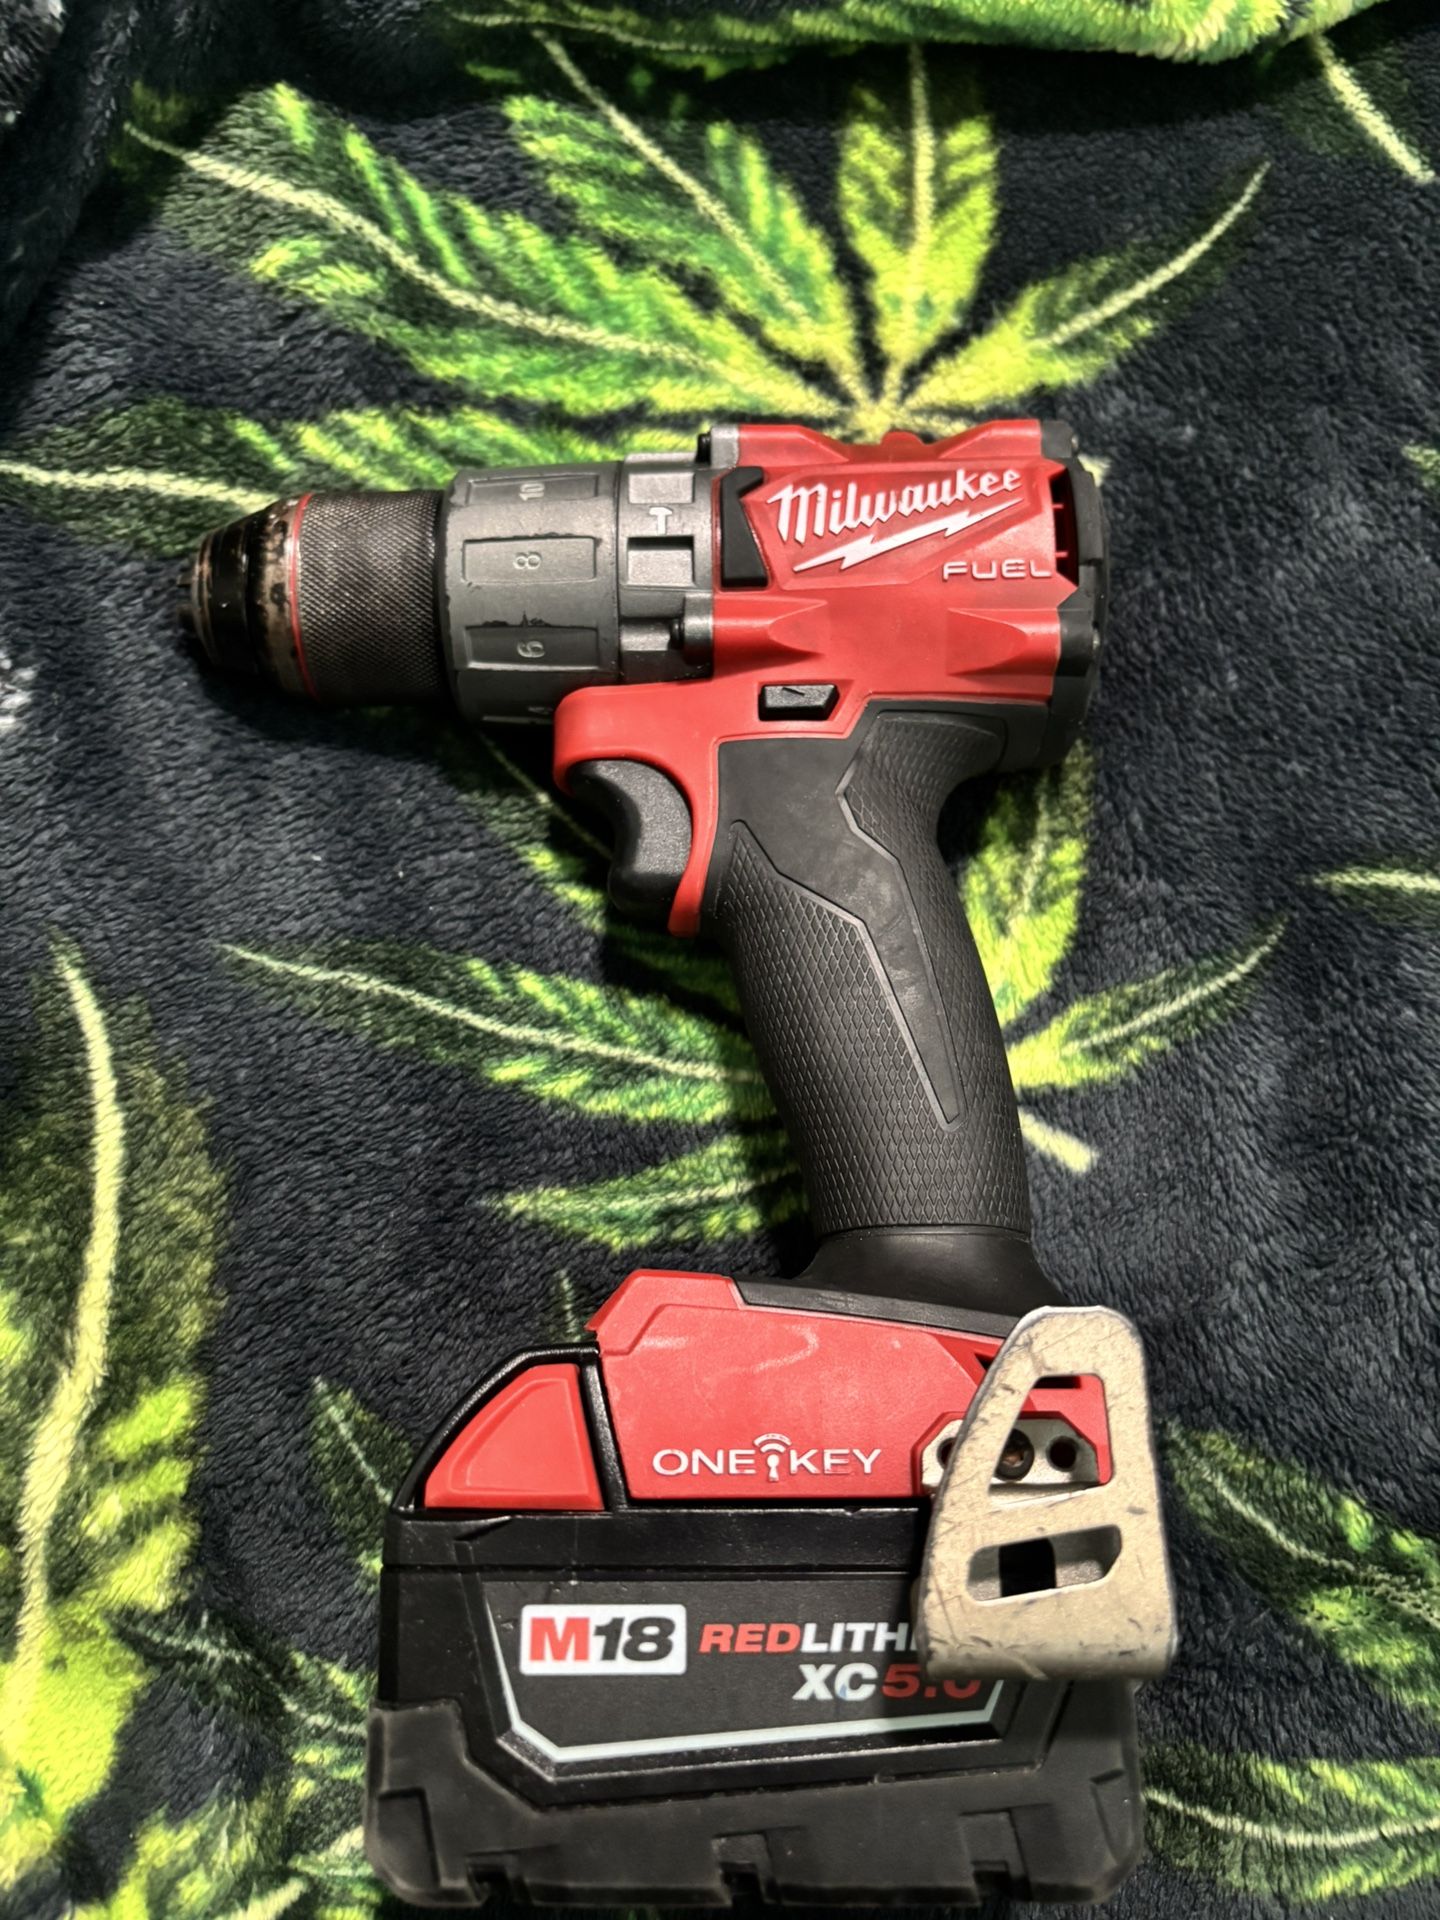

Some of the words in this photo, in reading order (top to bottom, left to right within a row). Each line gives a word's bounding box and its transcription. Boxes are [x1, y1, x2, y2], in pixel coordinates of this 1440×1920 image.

[518, 482, 545, 501] 10
[766, 468, 1024, 544] Milwaukee
[512, 551, 542, 570] 8
[942, 558, 1052, 581] FUEL
[652, 1448, 757, 1475] ONE
[789, 1448, 882, 1475] KEY
[529, 1616, 676, 1662] M18
[699, 1621, 919, 1654] REDLITH
